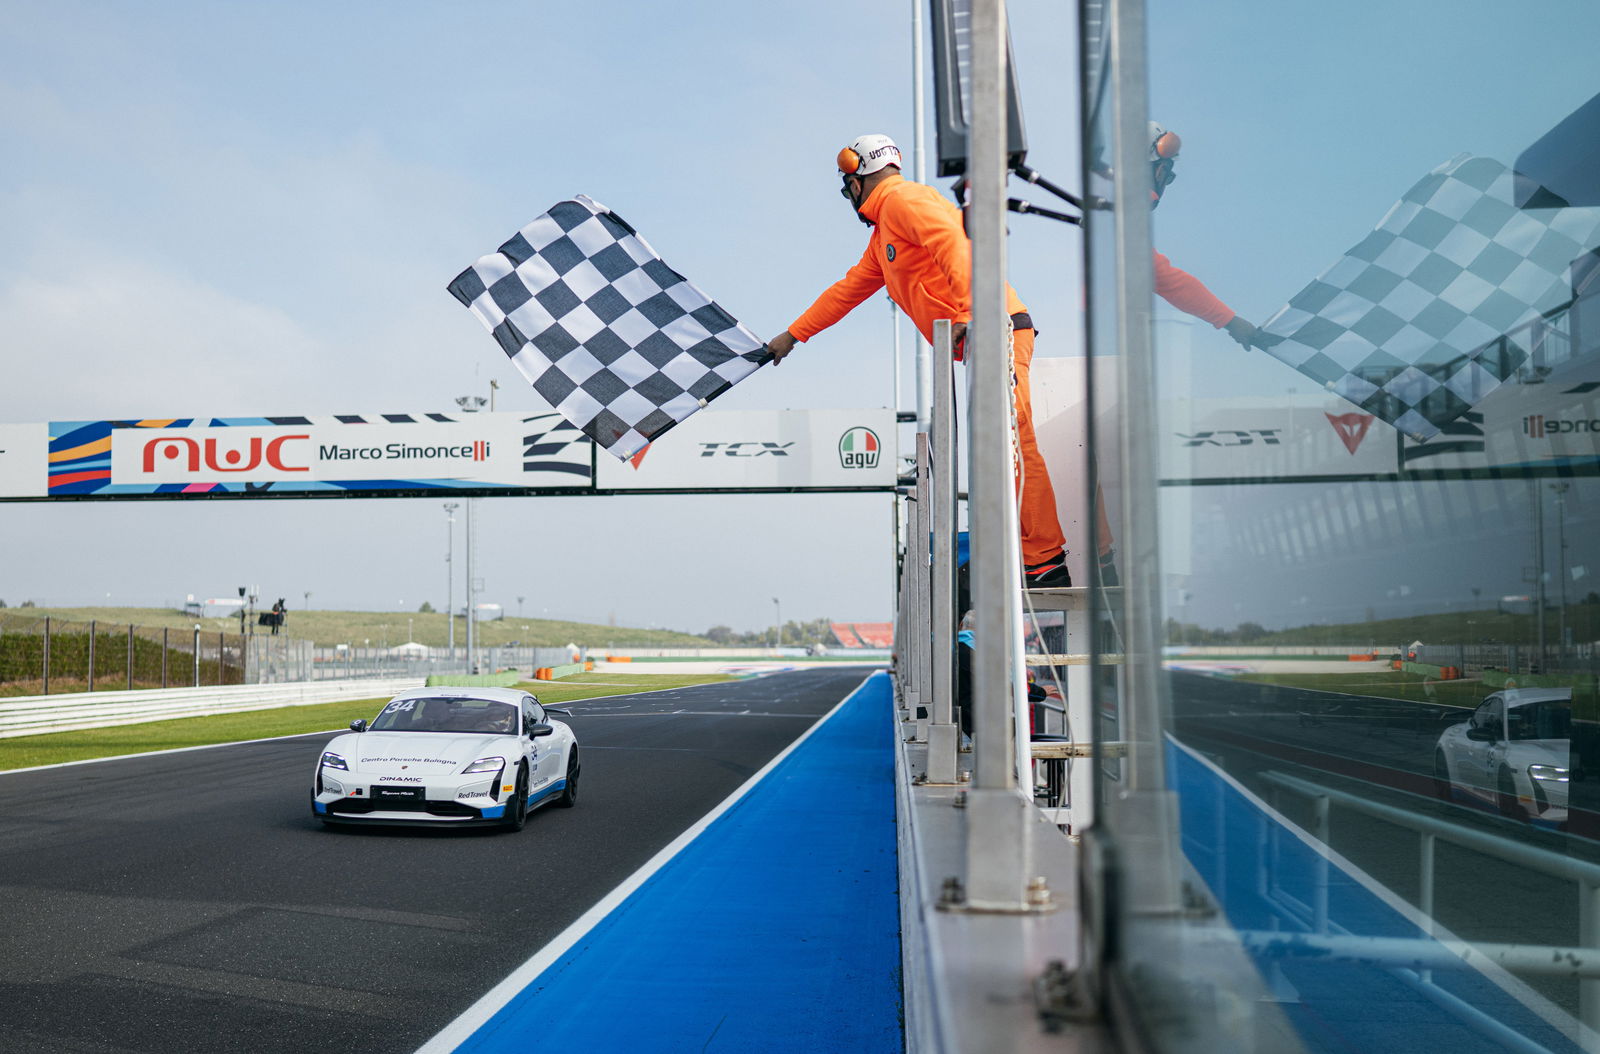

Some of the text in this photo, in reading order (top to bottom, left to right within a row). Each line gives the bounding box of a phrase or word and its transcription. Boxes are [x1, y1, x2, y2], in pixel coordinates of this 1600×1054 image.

[319, 440, 490, 461] Marco Simoncelli
[699, 441, 796, 457] TCX
[845, 452, 876, 469] agv
[385, 700, 416, 714] 34
